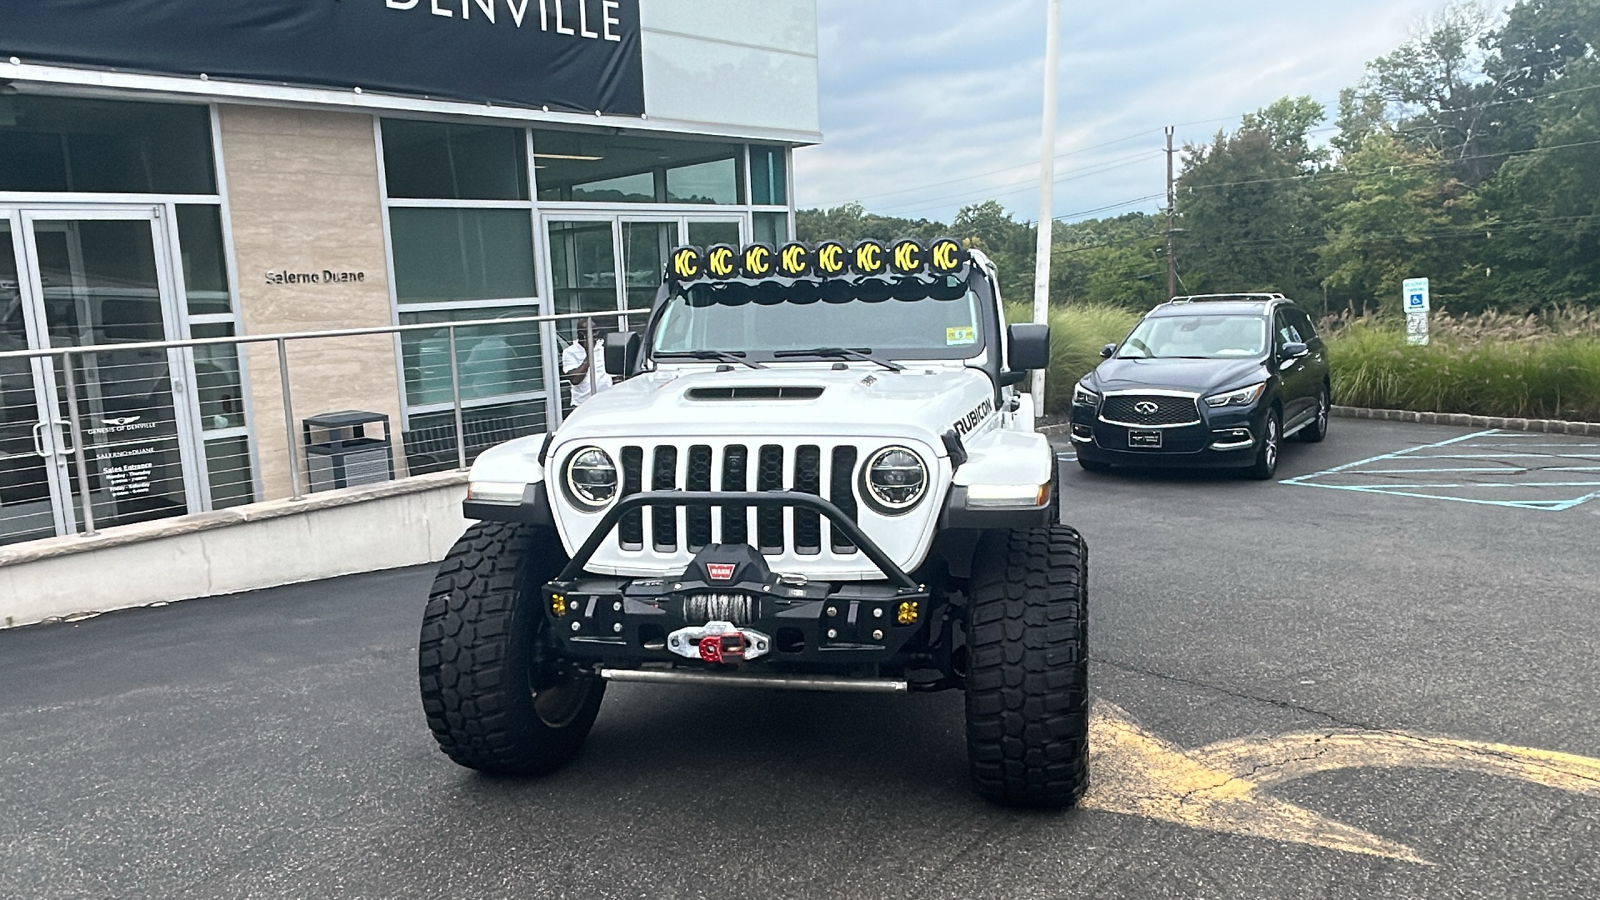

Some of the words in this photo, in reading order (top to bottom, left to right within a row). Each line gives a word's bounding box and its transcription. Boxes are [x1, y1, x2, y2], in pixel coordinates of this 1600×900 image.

[385, 0, 621, 42] NVILLE
[674, 250, 697, 277] KC
[710, 248, 733, 276] KC
[746, 247, 769, 274] KC
[782, 245, 806, 274] KC
[819, 244, 843, 272] KC
[857, 243, 881, 272] KC
[895, 242, 919, 271] KC
[933, 242, 958, 270] KC
[265, 270, 319, 284] Salerno
[323, 270, 365, 283] Duane
[126, 422, 156, 430] DENVILLE
[953, 397, 992, 438] RUBICON
[123, 462, 152, 471] Entrance
